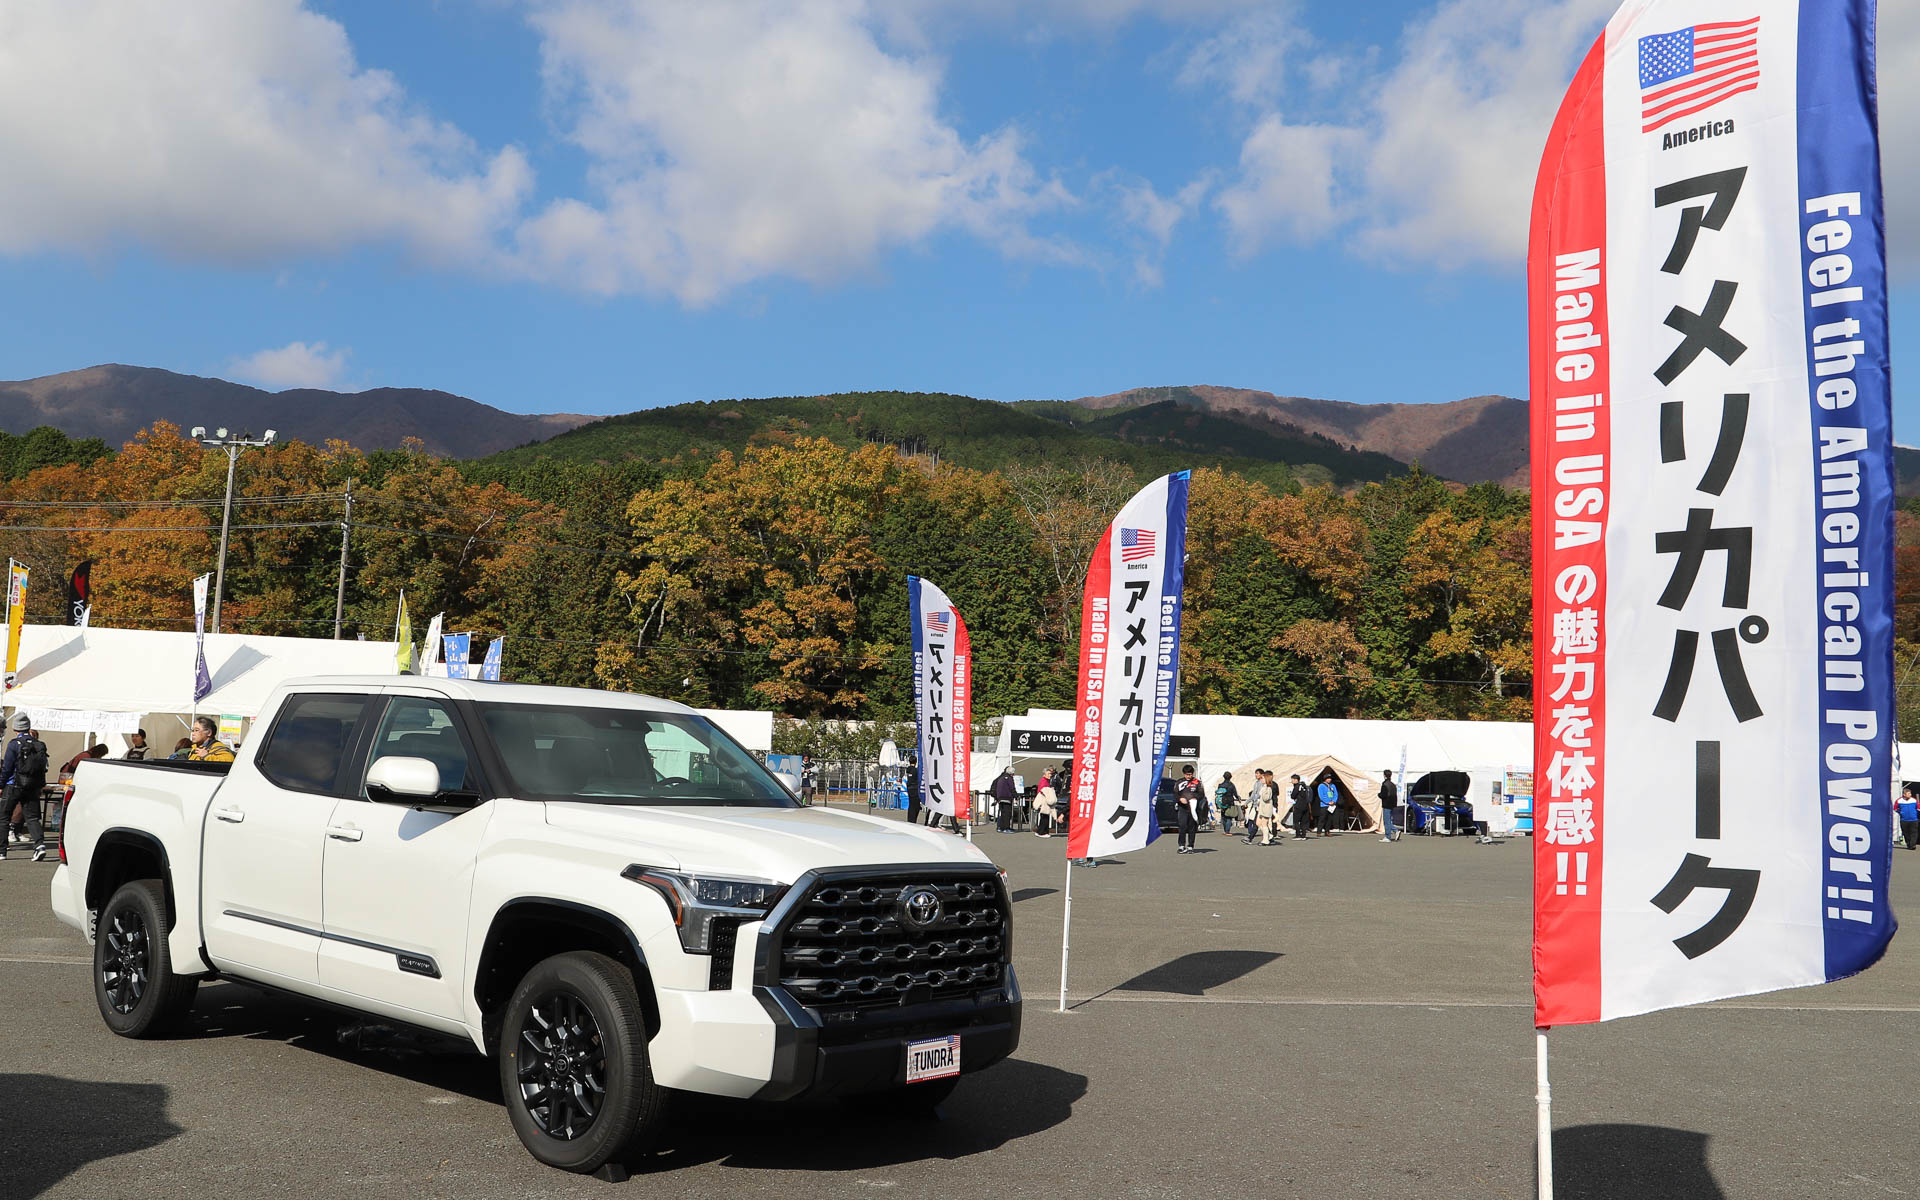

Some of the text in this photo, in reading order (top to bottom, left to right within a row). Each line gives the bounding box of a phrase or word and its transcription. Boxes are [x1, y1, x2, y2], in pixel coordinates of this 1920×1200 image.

[1662, 117, 1735, 152] America
[1554, 247, 1602, 383] Made
[1554, 393, 1603, 443] in
[1554, 453, 1605, 551] USA
[1127, 562, 1148, 570] America
[1649, 165, 1769, 960] アメリカパーク
[1805, 191, 1878, 925] Feel the American Power!!
[1090, 597, 1108, 644] Made
[1161, 595, 1176, 632] Feel
[1088, 647, 1106, 664] in
[1158, 634, 1175, 665] the
[1085, 668, 1104, 701] USA
[1108, 580, 1150, 840] アメリカパーク
[914, 1047, 954, 1072] TUNDRA
